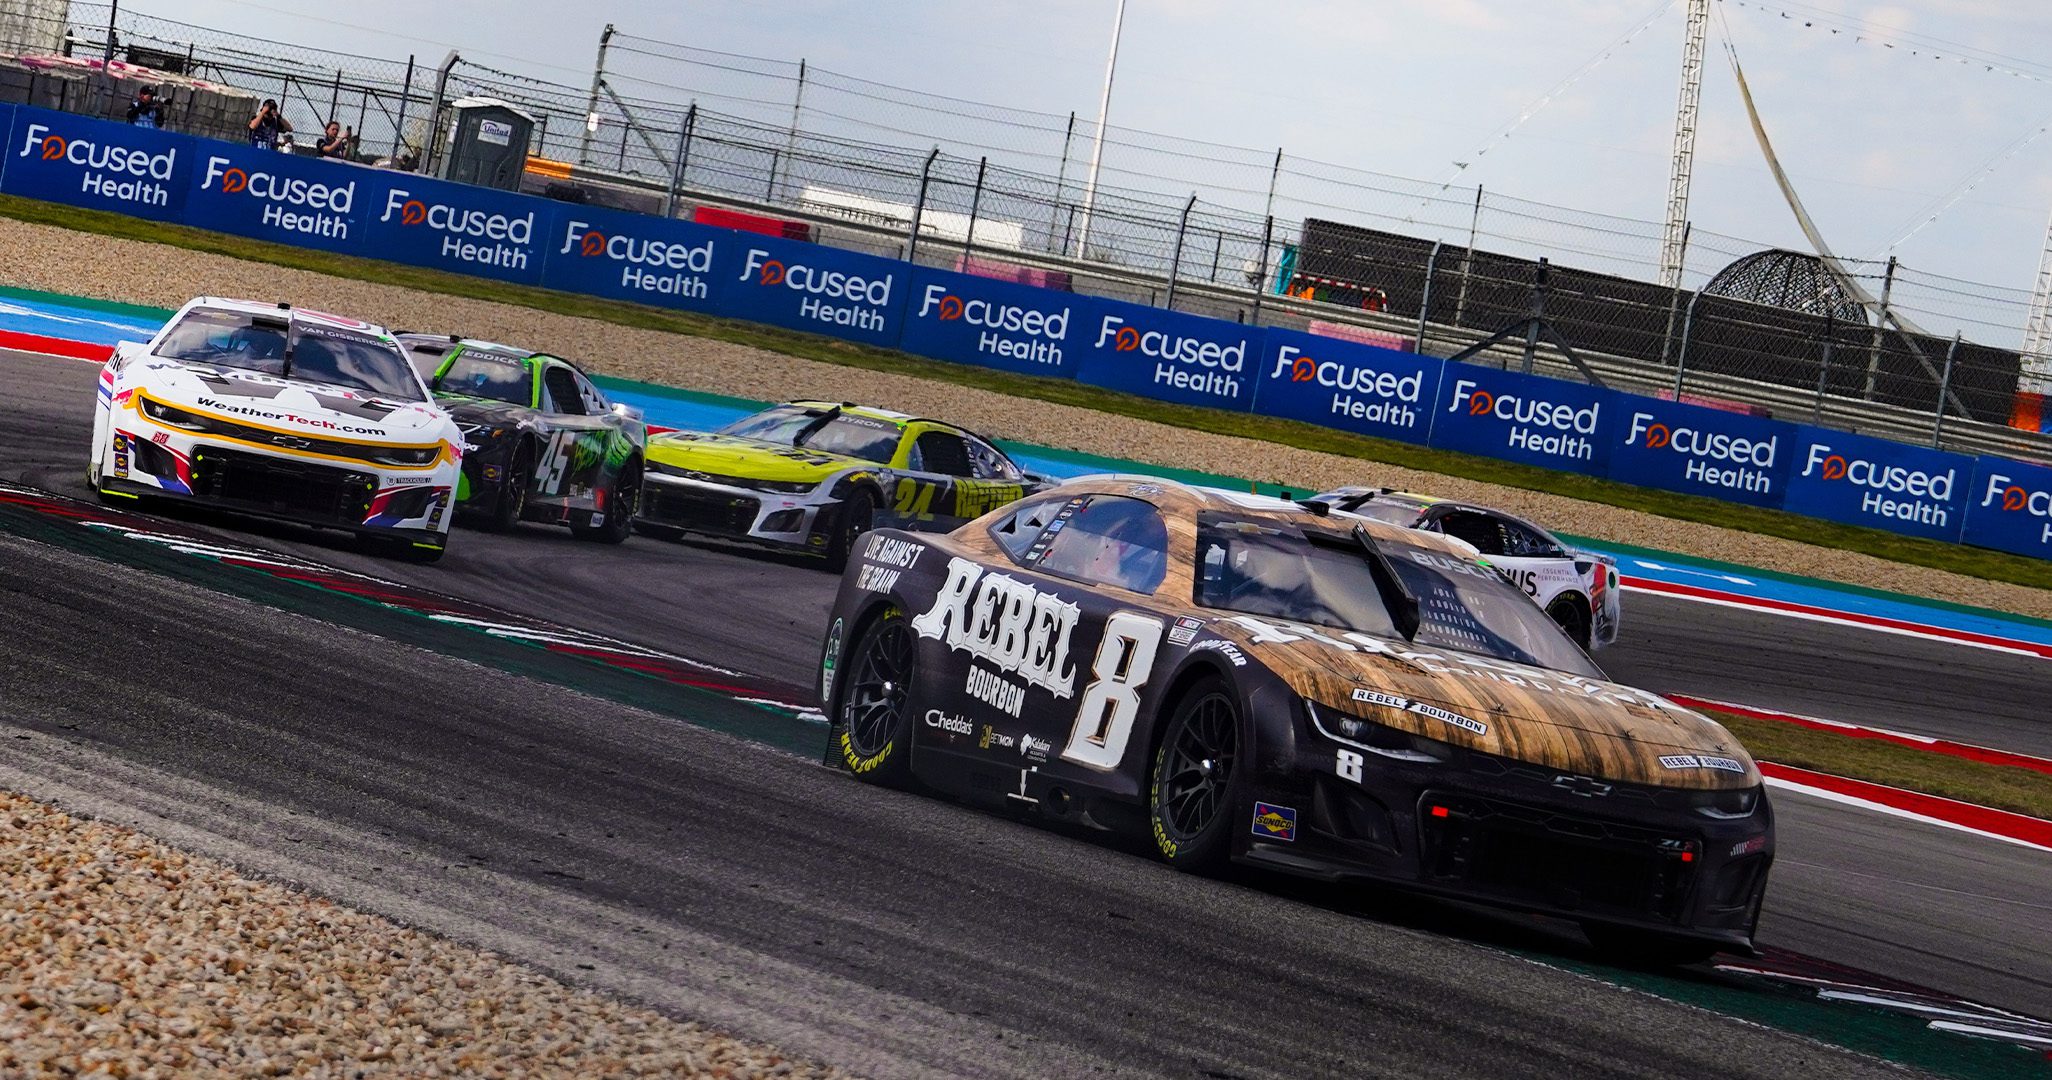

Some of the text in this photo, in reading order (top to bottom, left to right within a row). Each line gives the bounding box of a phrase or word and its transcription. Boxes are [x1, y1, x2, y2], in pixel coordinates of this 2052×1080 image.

[20, 125, 175, 181] Focused
[82, 172, 168, 206] Health
[202, 157, 355, 213] Focused
[263, 205, 347, 240] Health
[381, 189, 533, 244] Focused
[443, 237, 526, 269] Health
[561, 222, 713, 273] Focused
[623, 267, 706, 299] Health
[740, 250, 892, 306] Focused
[298, 326, 325, 335] VAN
[801, 298, 883, 331] Health
[919, 285, 1069, 340] Focused
[461, 350, 519, 366] EDDICK
[980, 332, 1062, 365] Health
[1095, 316, 1245, 372] Focused
[1155, 363, 1238, 398] Health
[1272, 346, 1422, 402] Focused
[197, 397, 386, 436] WeatherTech.com
[840, 416, 884, 428] BYRON
[1332, 394, 1414, 427] Health
[1449, 380, 1599, 435] Focused
[1509, 427, 1591, 460] Health
[1626, 413, 1776, 468] Focused
[535, 431, 575, 495] 45
[1686, 460, 1769, 493] Health
[1802, 444, 1954, 501] Focused
[894, 477, 936, 521] 24
[1863, 492, 1945, 527] Health
[1982, 474, 2052, 517] Foc
[877, 538, 925, 569] AGAINST
[1408, 551, 1504, 584] BUSCH
[856, 564, 901, 594] THE GRAIN
[910, 556, 1081, 699] REBEL
[966, 665, 1025, 718] BOURBON
[1060, 610, 1164, 771] 8
[925, 709, 973, 736] Cheddar's
[1358, 690, 1483, 732] REBEL BOURBON
[841, 732, 893, 774] GOODYEAR
[989, 732, 1015, 748] BETMGM
[1336, 748, 1364, 785] 8
[1662, 756, 1741, 770] REBEL BOURBON
[1256, 815, 1295, 829] SUNOCO
